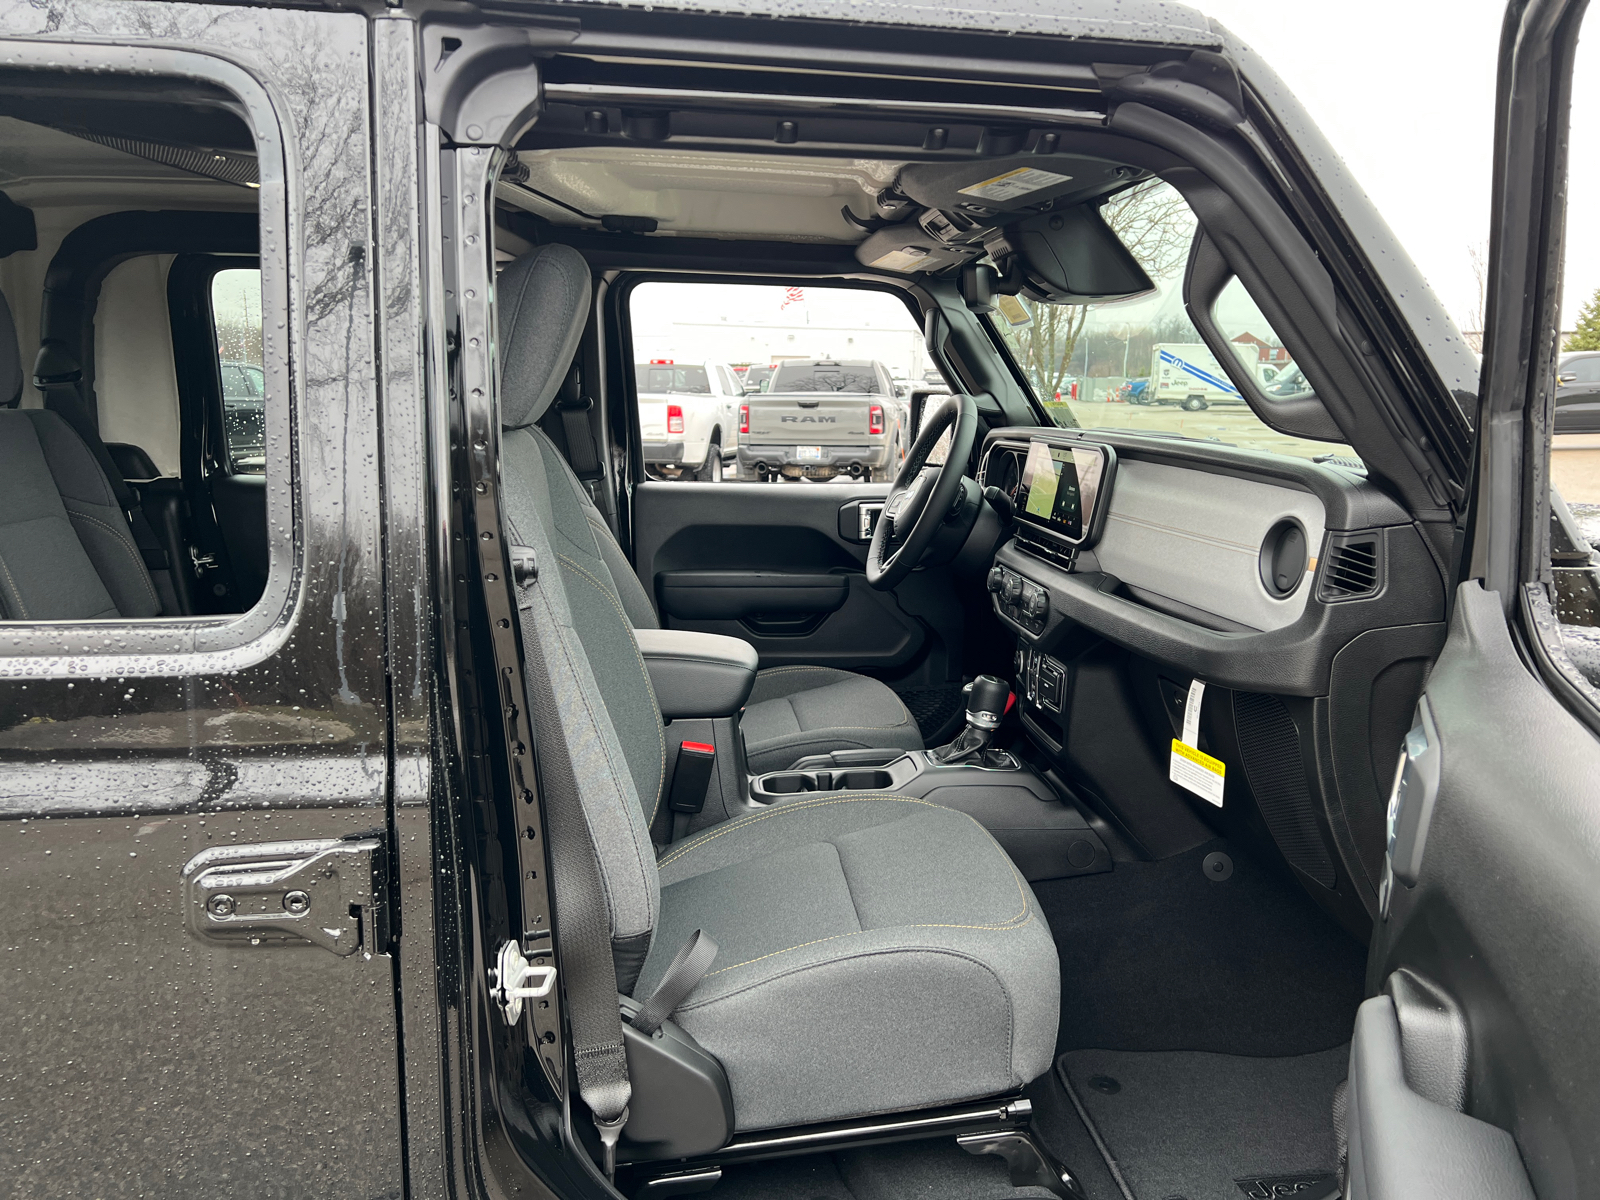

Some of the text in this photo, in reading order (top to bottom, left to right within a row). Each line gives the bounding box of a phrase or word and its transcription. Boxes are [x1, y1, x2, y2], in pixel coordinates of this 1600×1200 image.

[1184, 746, 1199, 757] VEHICLE
[1204, 756, 1222, 769] EQUIPPED
[1185, 753, 1204, 766] ADVANCED
[1212, 766, 1222, 775] BAGS
